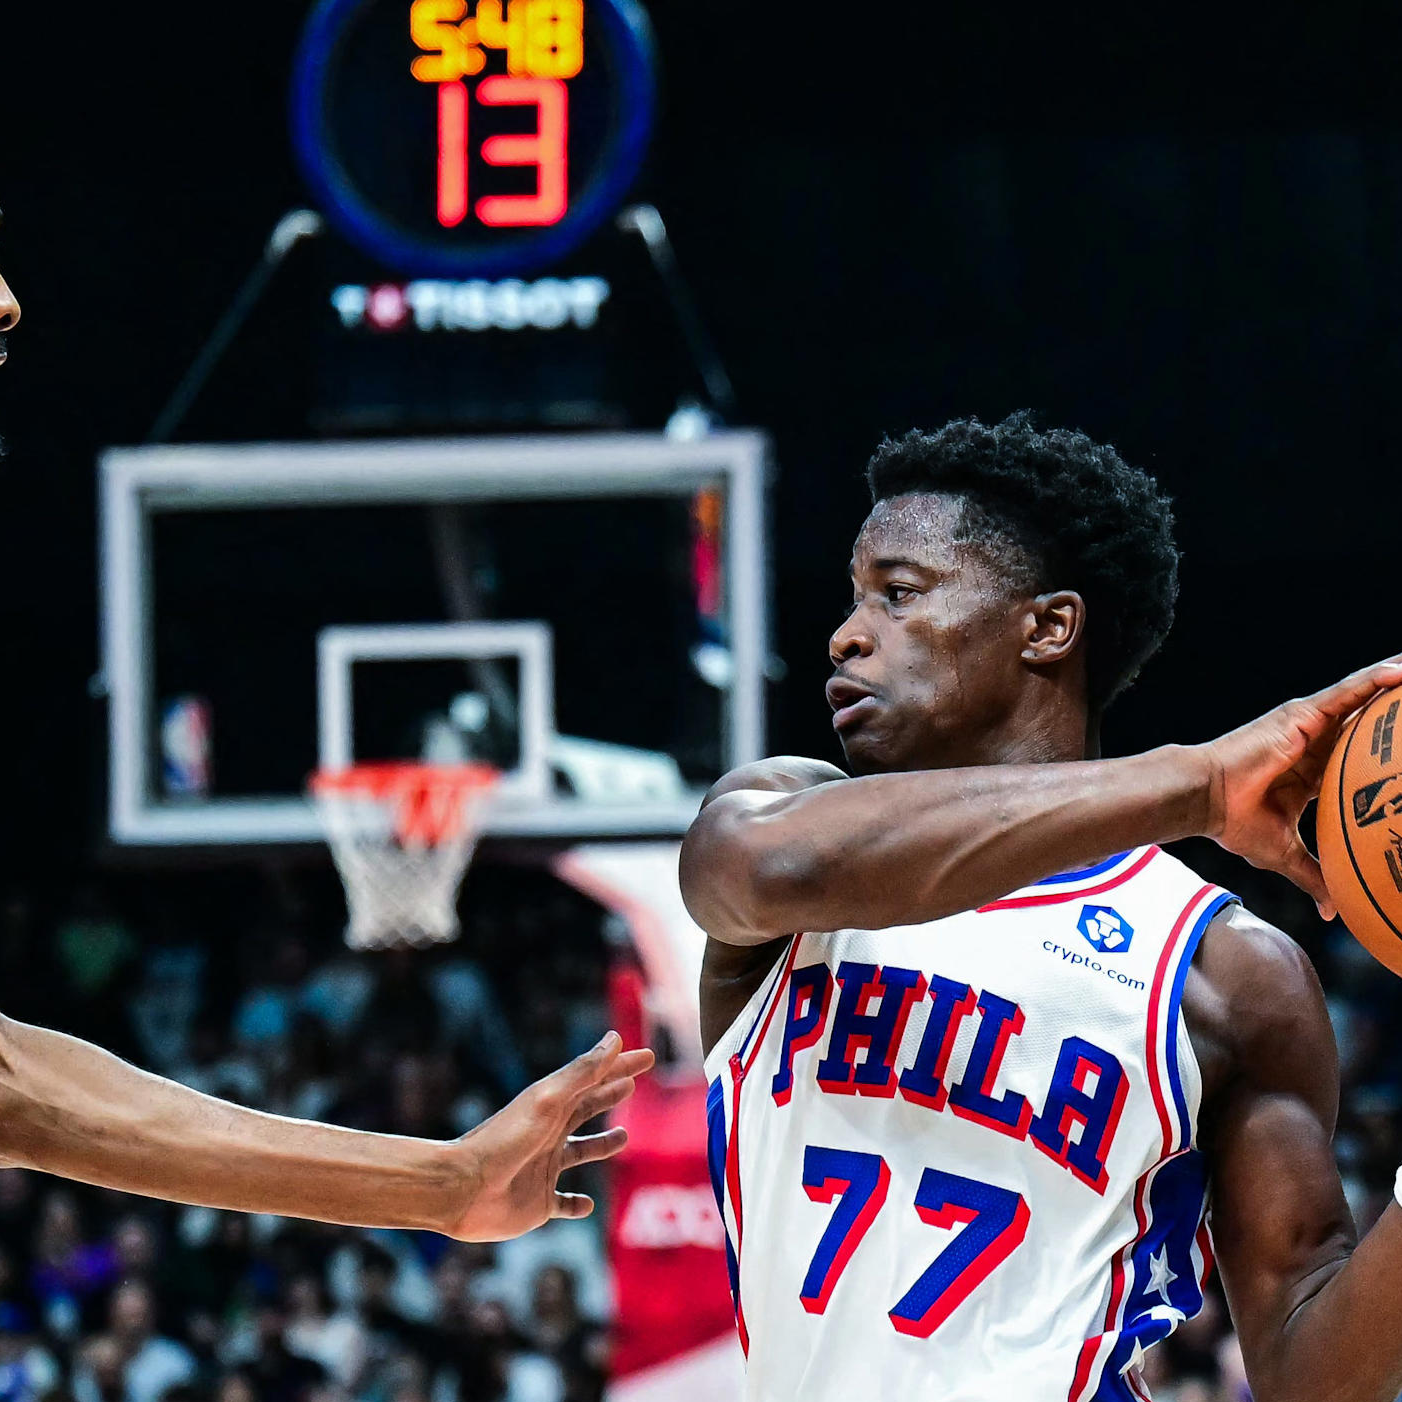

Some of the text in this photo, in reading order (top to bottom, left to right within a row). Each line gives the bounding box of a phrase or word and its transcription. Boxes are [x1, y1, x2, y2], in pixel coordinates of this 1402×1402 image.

[410, 0, 584, 82] 5:48
[436, 74, 569, 228] 13
[1042, 939, 1146, 991] crypto.com
[771, 960, 1130, 1197] PHILA
[799, 1144, 1032, 1340] 77
